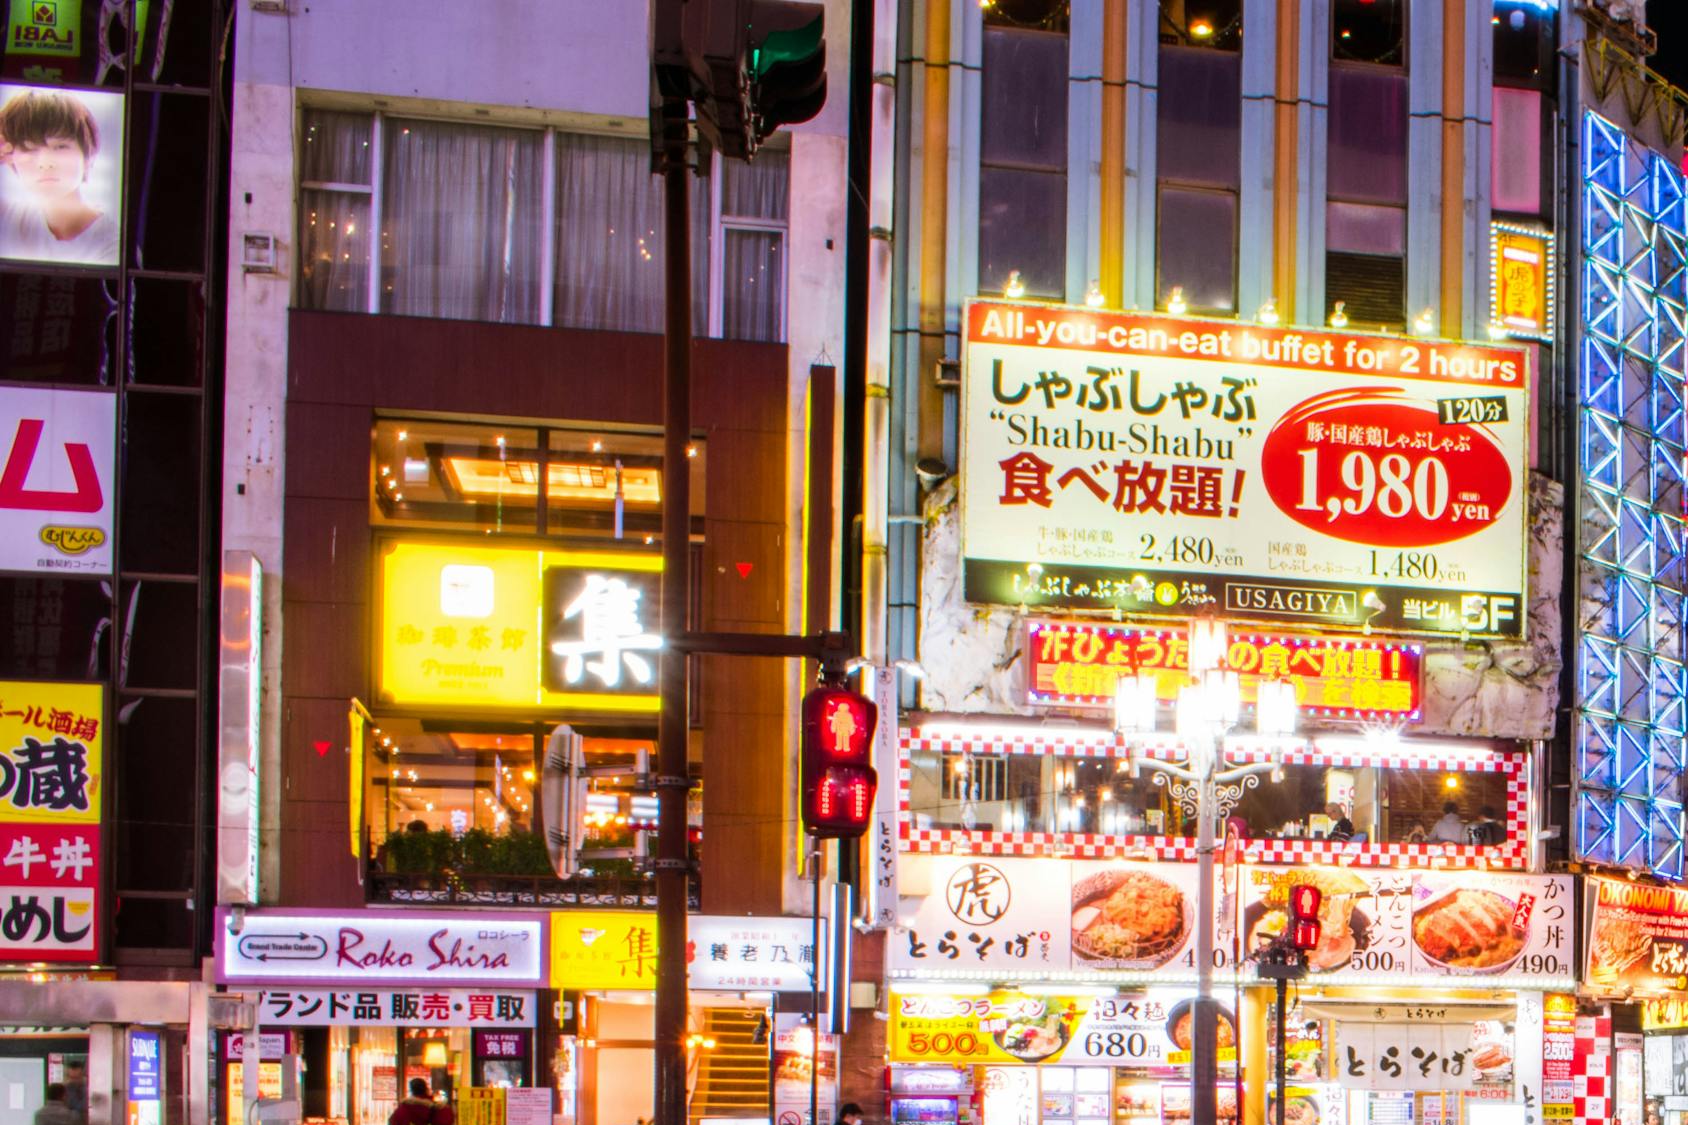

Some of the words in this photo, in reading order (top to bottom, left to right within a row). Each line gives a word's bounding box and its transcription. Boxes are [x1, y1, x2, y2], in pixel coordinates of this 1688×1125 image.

[982, 309, 1232, 356] All-you-can-eat
[1242, 331, 1335, 367] buffet
[1344, 340, 1392, 370] for
[1400, 346, 1420, 374] 2
[1430, 346, 1517, 383] hours
[991, 358, 1259, 422] しゃぶしゃぶ
[1444, 398, 1503, 424] 120分
[1307, 421, 1471, 452] 豚・国産鶏しゃぶしゃぶ
[998, 451, 1247, 519] 食べ放題!
[1296, 449, 1449, 522] 1,980
[1452, 502, 1490, 521] yen
[45, 528, 102, 553] むじんくん
[1038, 527, 1114, 544] 牛・豚・国産鶏
[1140, 533, 1215, 565] 2,480
[1215, 552, 1244, 568] yen
[36, 557, 108, 570] 自動契約コーナー
[1369, 550, 1438, 578] 1,480
[1438, 567, 1467, 583] yen
[1235, 587, 1350, 615] USAGIYA
[1402, 598, 1455, 620] 当ビル
[1461, 595, 1515, 632] 5F
[0, 703, 99, 743] ール酒場
[3, 836, 94, 882] 牛丼
[953, 863, 1003, 922] 虎
[1600, 881, 1670, 911] OKONOMI
[0, 895, 91, 944] めし
[1370, 877, 1384, 947] ラーメン
[1388, 875, 1406, 949] とんこつ
[1543, 877, 1565, 949] かつ丼
[336, 927, 413, 970] Roko
[427, 928, 510, 971] Shira
[477, 929, 530, 942] ロコシーラ
[616, 925, 657, 978] 集
[909, 929, 1036, 961] とらそば
[710, 942, 815, 963] 養老乃瀧
[1351, 951, 1405, 972] 500円
[1516, 954, 1568, 975] 490円
[391, 992, 525, 1022] 販売・買取
[1405, 1008, 1448, 1019] とらそば
[484, 1034, 499, 1042] TAX
[501, 1034, 520, 1042] FREE
[485, 1042, 517, 1056] 免税
[1085, 1032, 1161, 1058] 680円
[1345, 1045, 1473, 1078] とらそば
